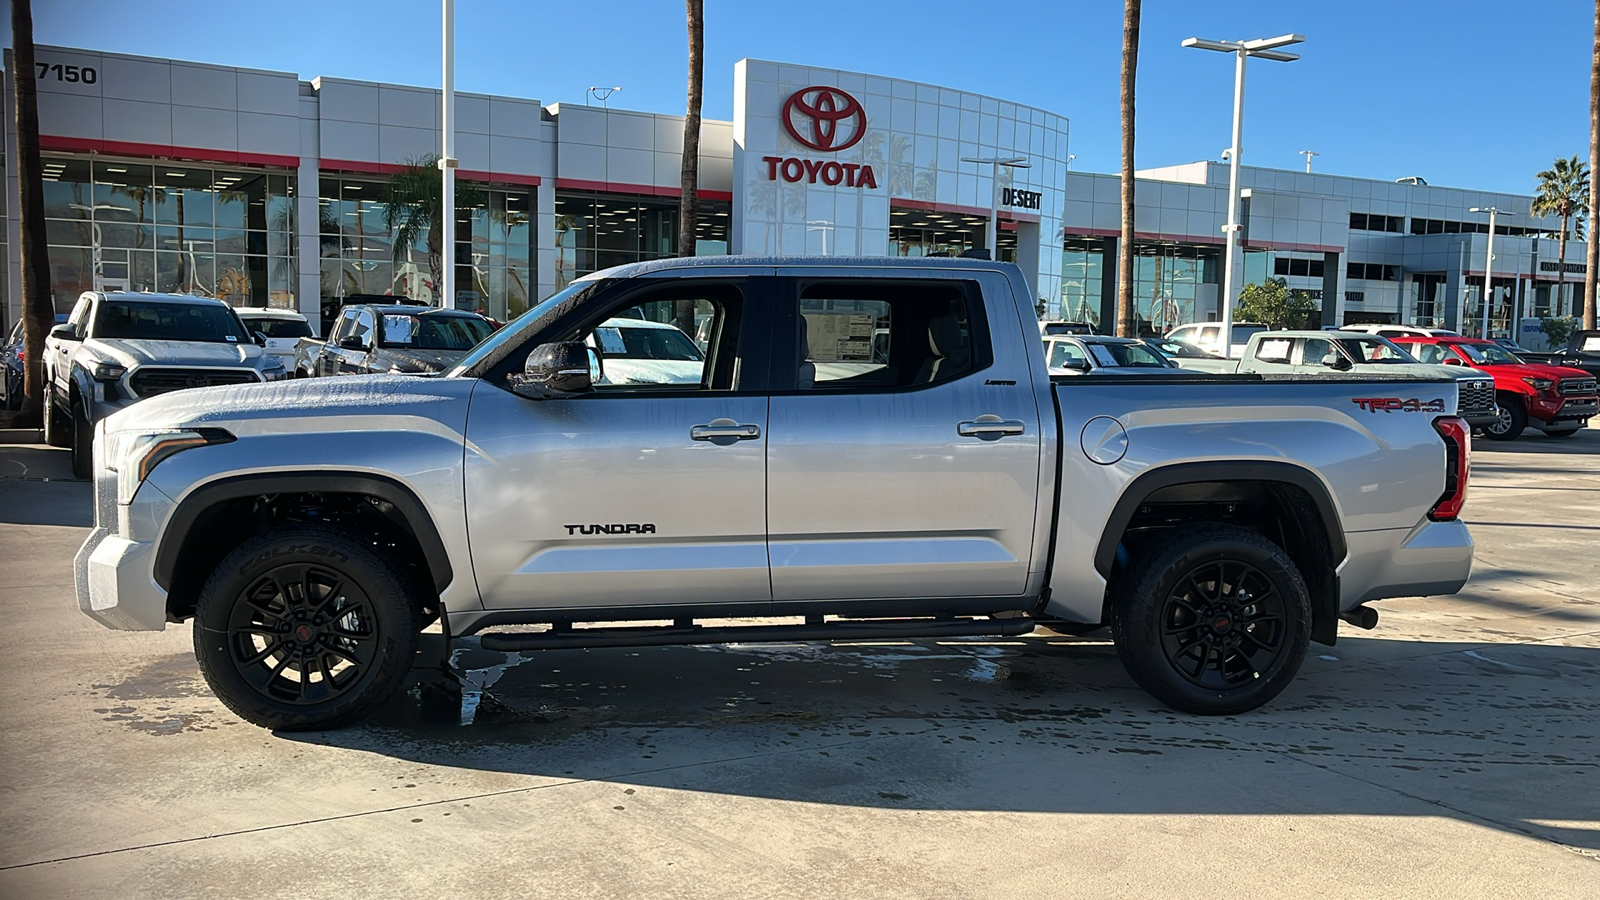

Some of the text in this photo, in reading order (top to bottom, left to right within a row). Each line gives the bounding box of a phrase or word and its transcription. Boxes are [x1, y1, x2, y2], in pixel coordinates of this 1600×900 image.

[35, 62, 97, 84] 7150
[762, 156, 877, 188] TOYOTA
[1002, 188, 1042, 210] DESERT
[1352, 398, 1403, 413] TRD
[564, 524, 656, 535] TUNDRA
